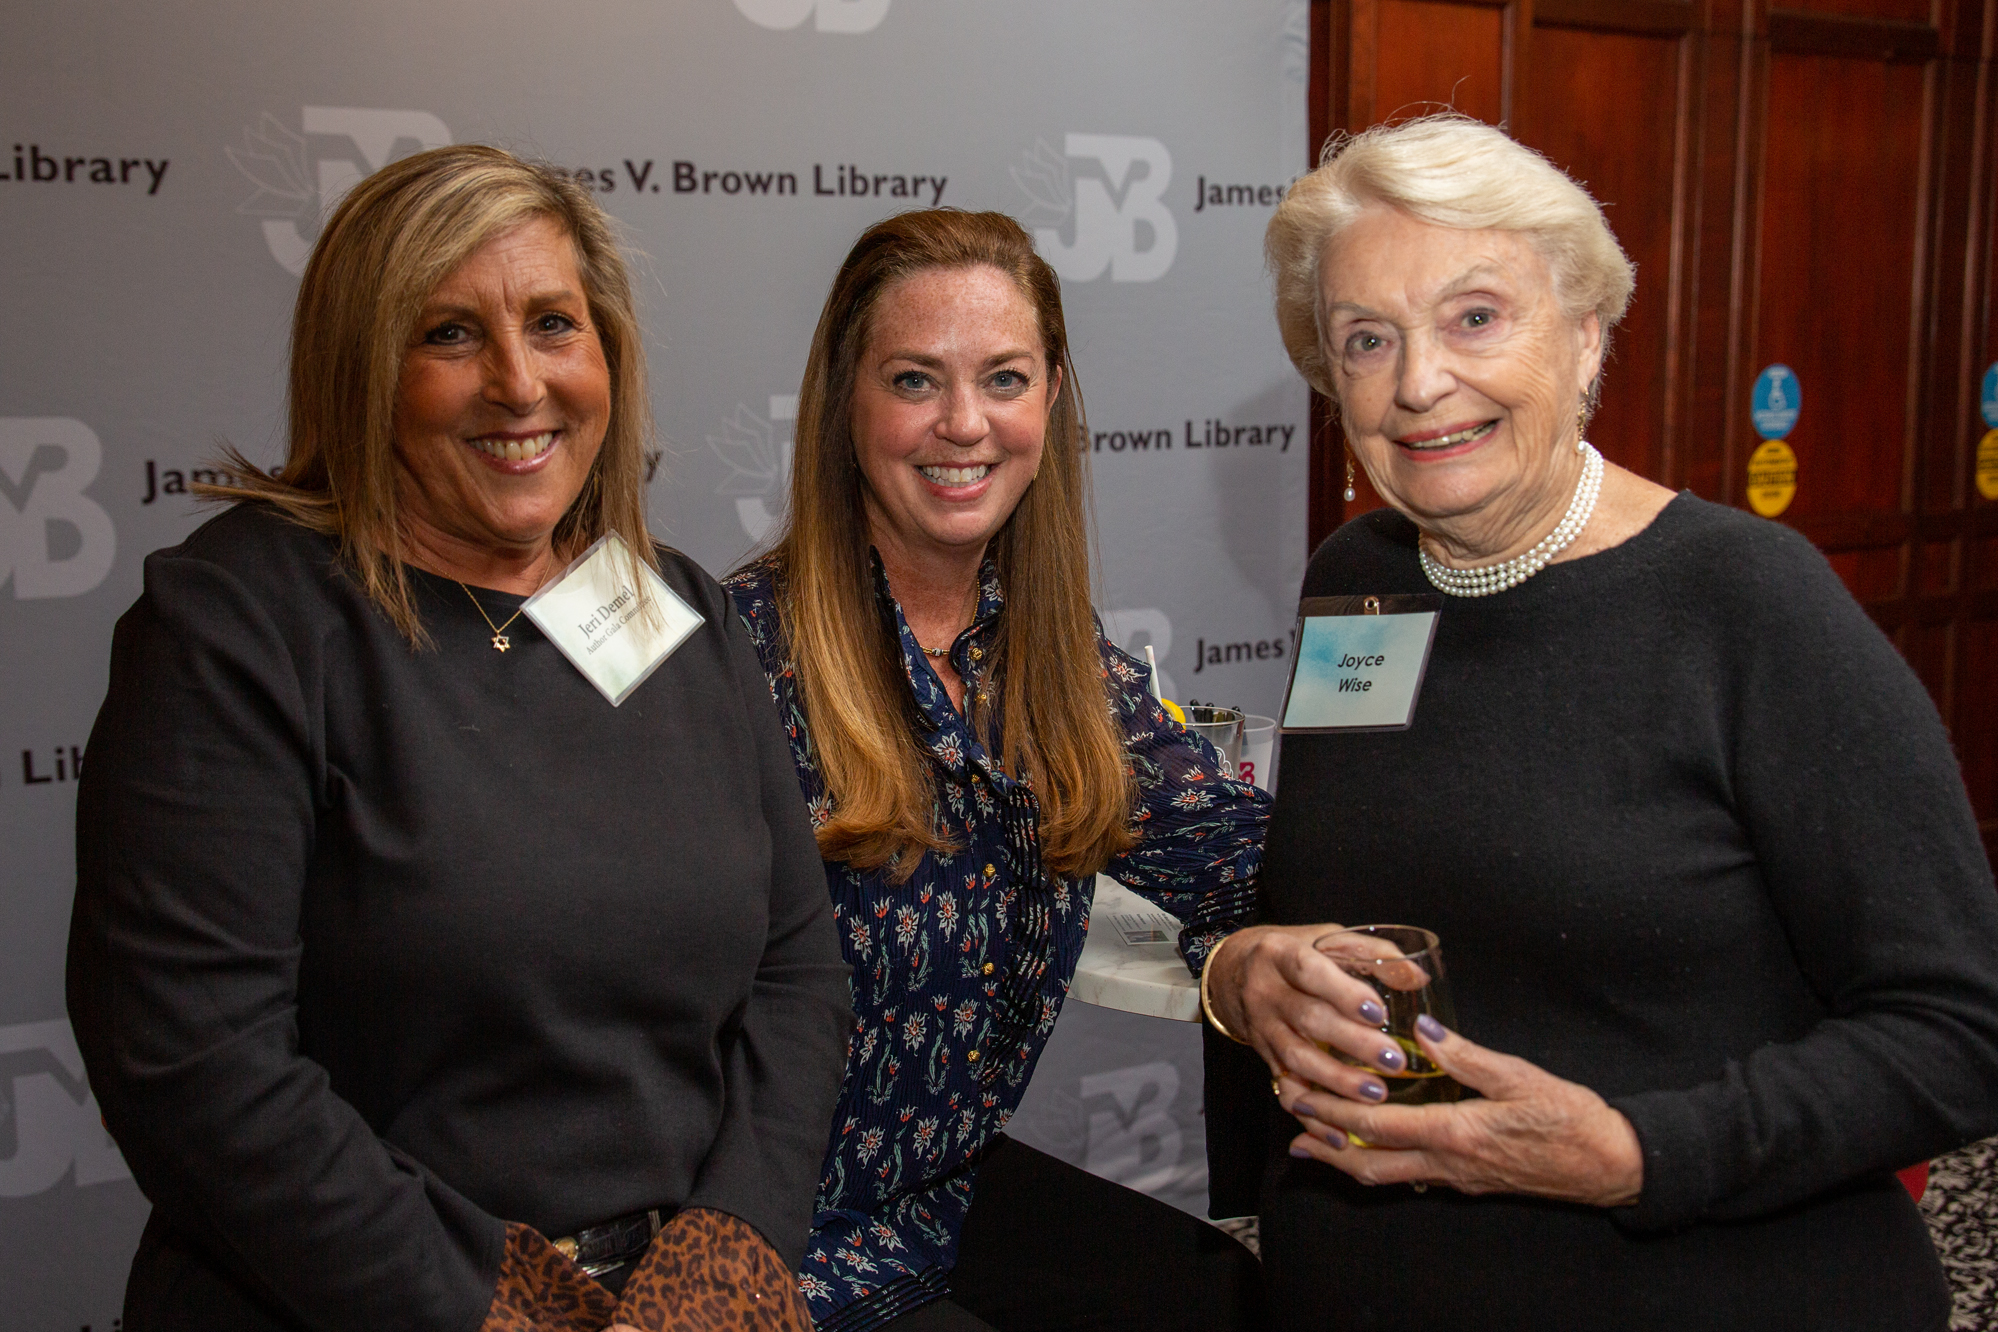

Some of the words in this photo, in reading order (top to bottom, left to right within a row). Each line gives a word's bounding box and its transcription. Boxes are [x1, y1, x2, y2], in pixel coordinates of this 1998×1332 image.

[624, 158, 660, 193] V.
[673, 159, 797, 195] Brown
[813, 164, 948, 206] Library
[1184, 419, 1295, 453] Library
[578, 613, 602, 639] Jeri
[596, 585, 634, 620] Demel
[586, 633, 607, 655] Author
[605, 623, 621, 636] Gala
[1193, 637, 1284, 674] James
[1337, 653, 1385, 671] Joyce
[1338, 677, 1372, 693] Wise
